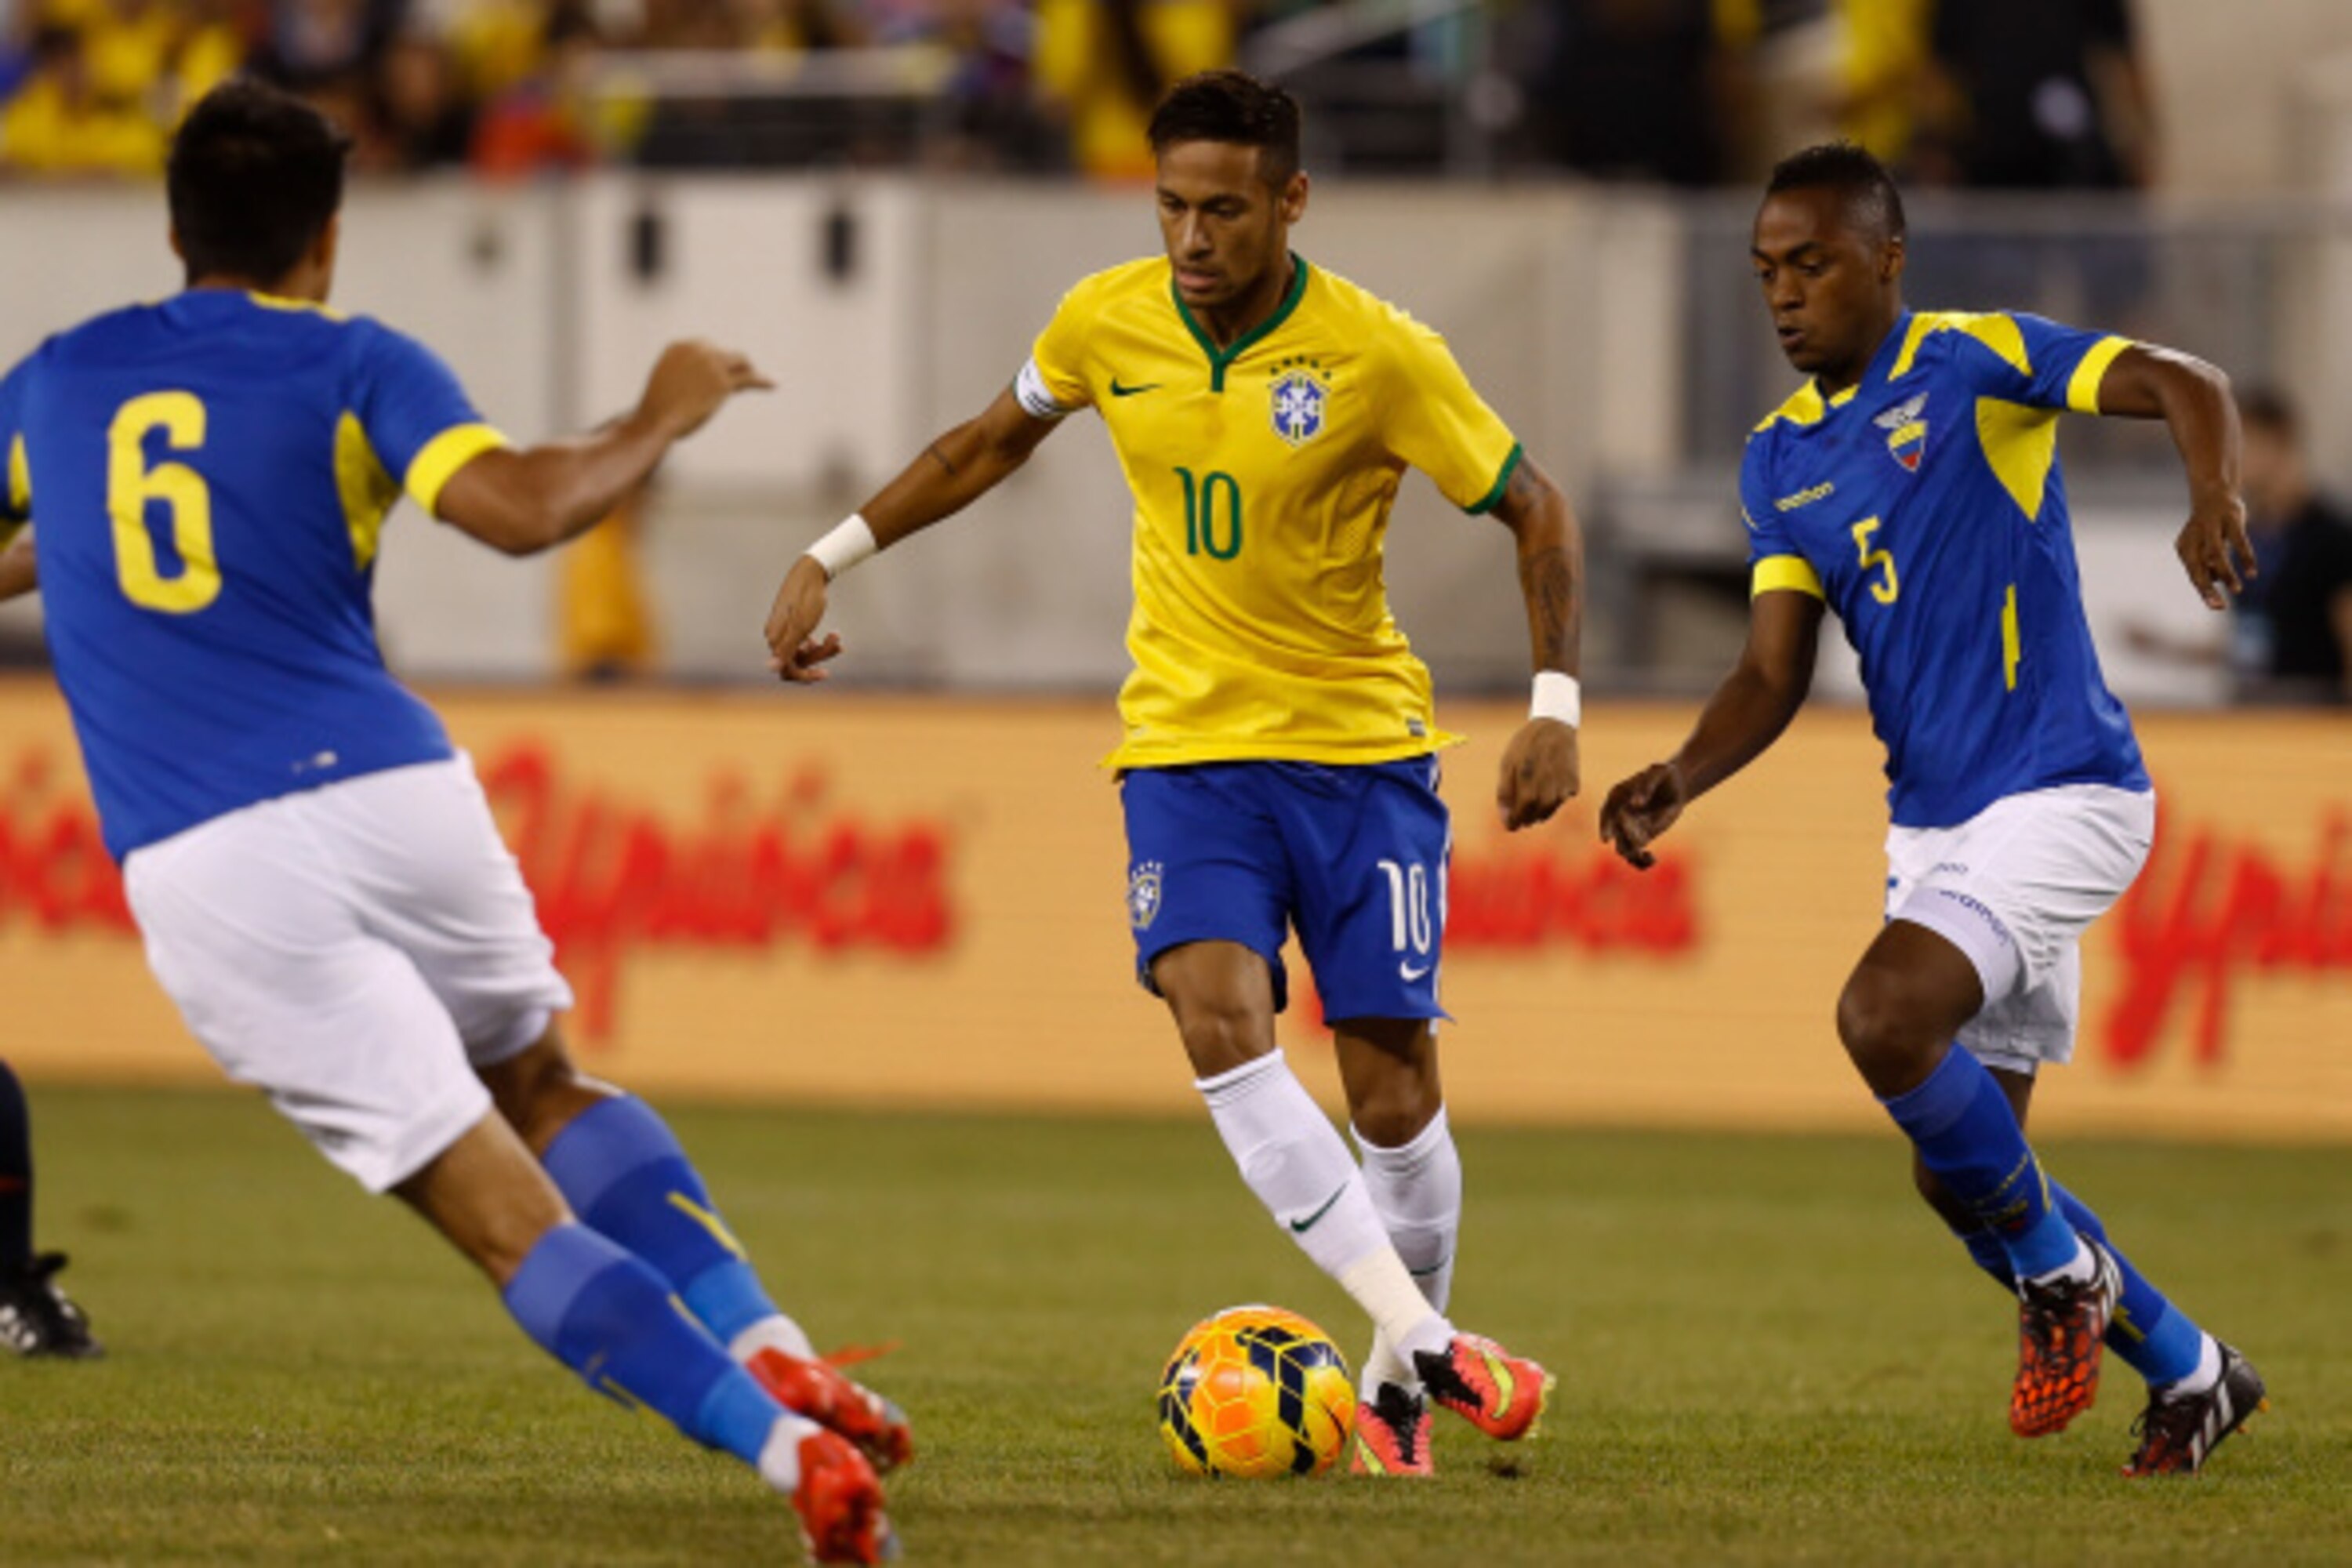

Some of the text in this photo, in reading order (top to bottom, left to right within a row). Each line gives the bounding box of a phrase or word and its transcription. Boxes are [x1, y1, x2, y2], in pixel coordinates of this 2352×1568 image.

[107, 390, 223, 613] 6
[1172, 466, 1243, 561] 10
[1852, 516, 1898, 604] 5
[1377, 859, 1431, 955] 10
